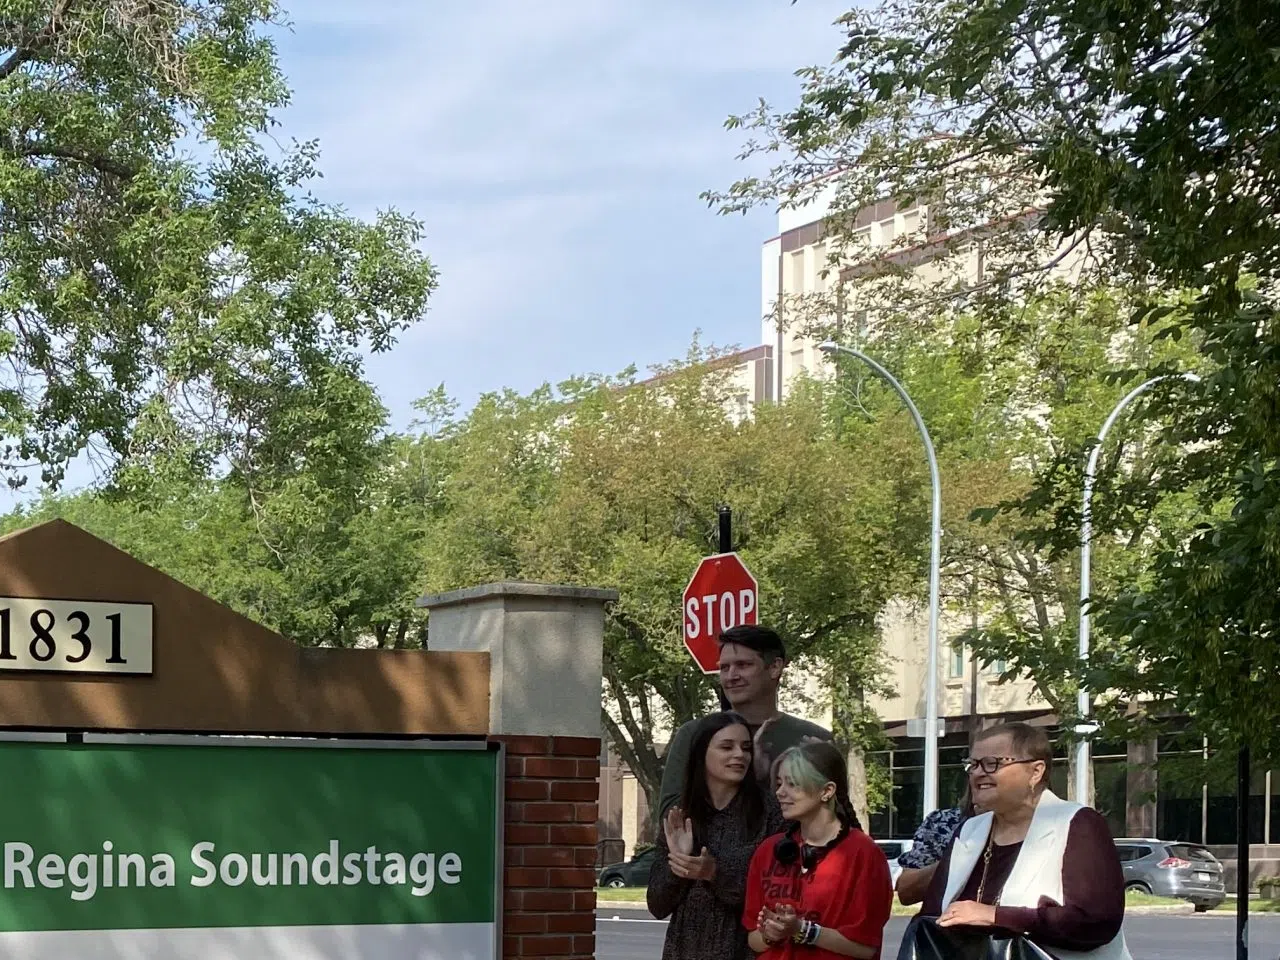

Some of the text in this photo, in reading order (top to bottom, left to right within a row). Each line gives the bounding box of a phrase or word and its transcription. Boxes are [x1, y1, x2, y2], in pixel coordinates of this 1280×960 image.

[686, 588, 755, 639] STOP
[4, 840, 176, 901] Regina
[190, 840, 462, 896] Soundstage
